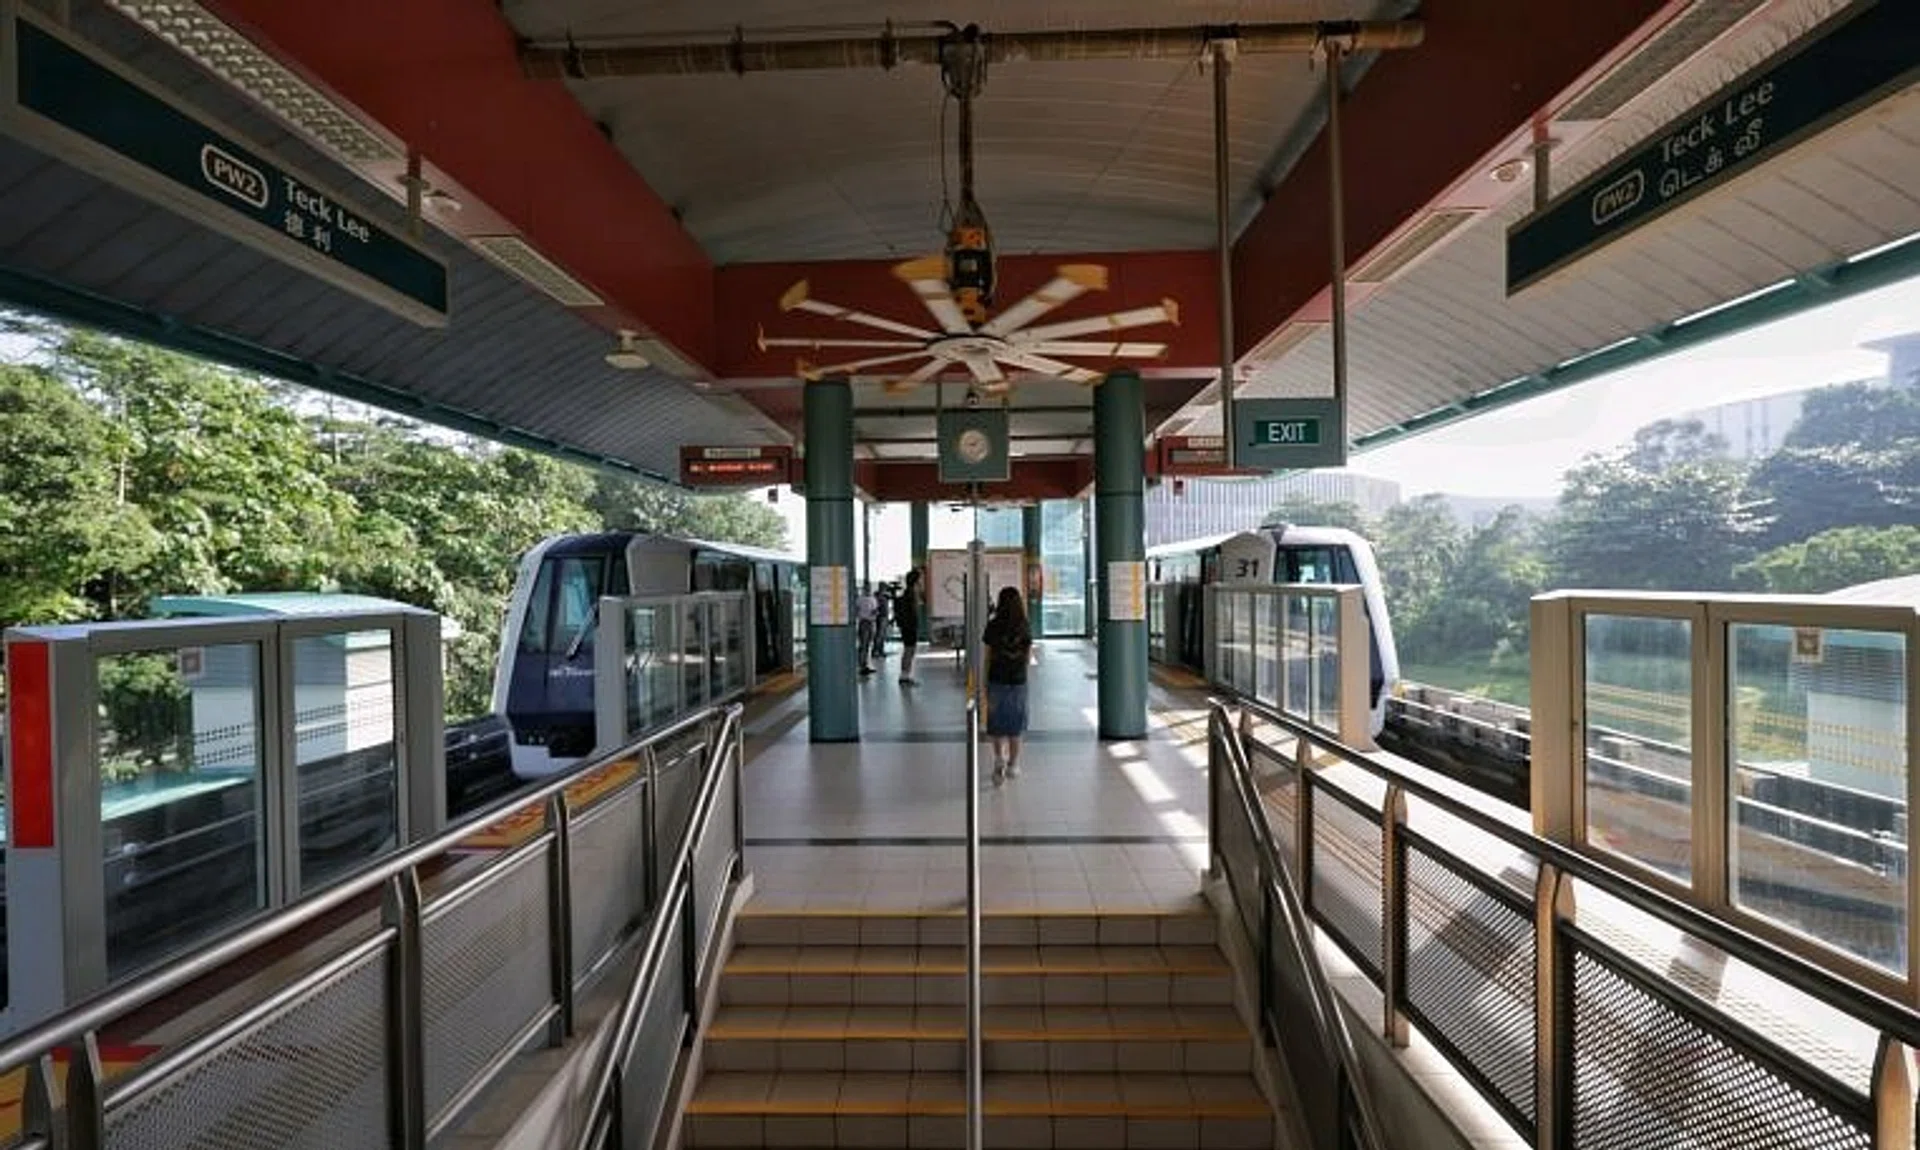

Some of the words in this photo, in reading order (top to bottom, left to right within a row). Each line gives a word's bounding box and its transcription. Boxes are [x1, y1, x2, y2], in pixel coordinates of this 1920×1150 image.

[1661, 114, 1716, 162] Teck
[1725, 83, 1774, 125] Lee
[213, 157, 259, 197] PW2
[282, 176, 332, 223] Teck
[337, 209, 370, 243] Lee
[1600, 182, 1635, 215] PW2
[1267, 422, 1308, 442] EXIT
[1235, 558, 1260, 578] 31
